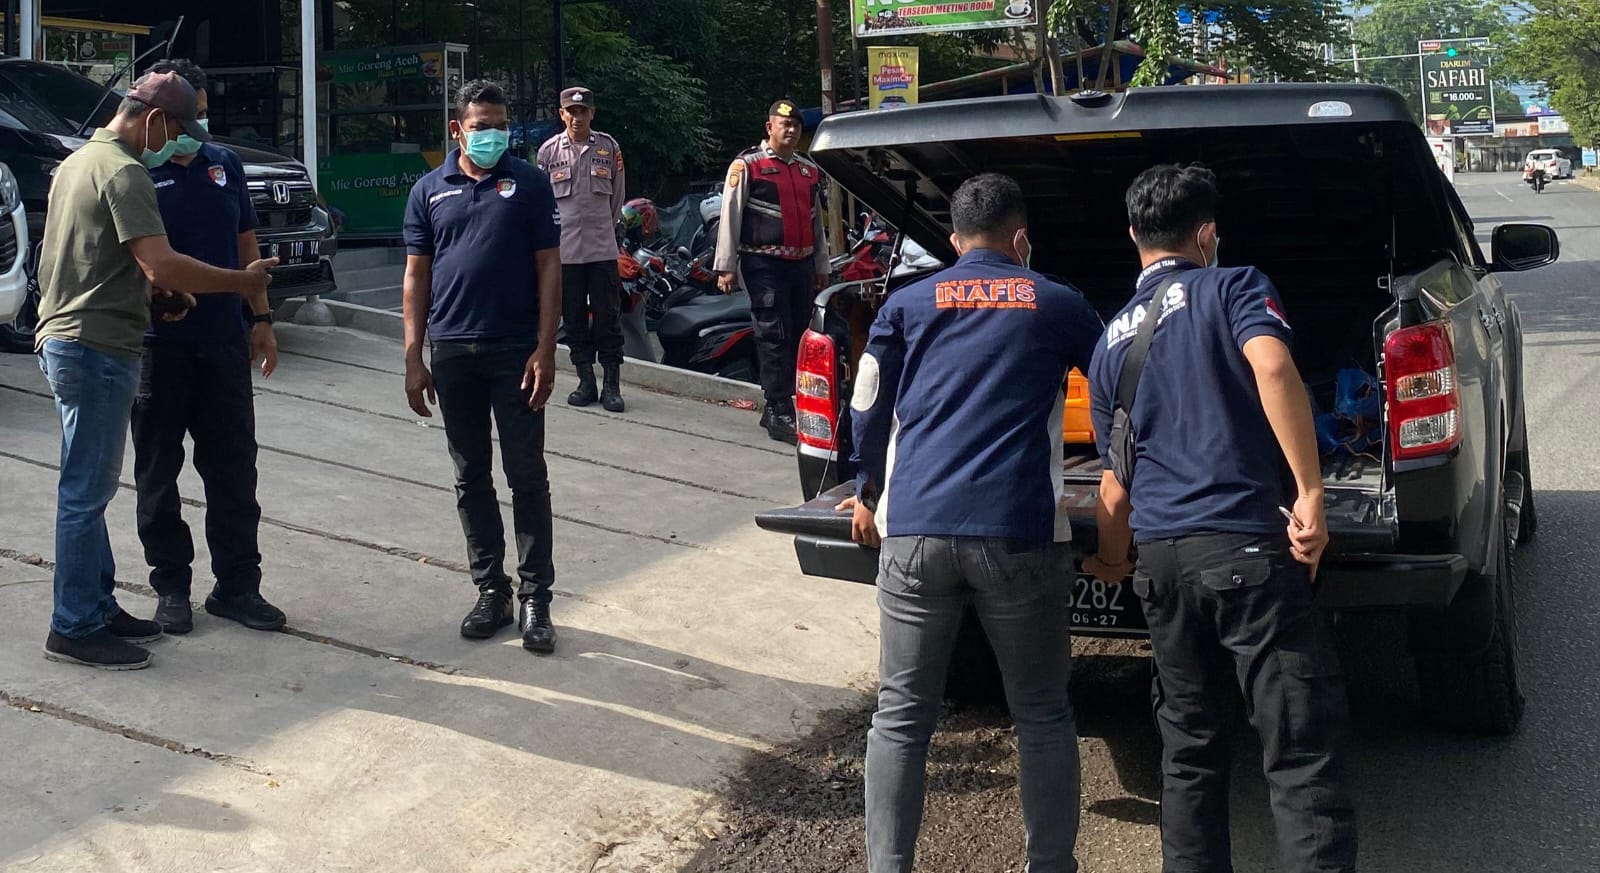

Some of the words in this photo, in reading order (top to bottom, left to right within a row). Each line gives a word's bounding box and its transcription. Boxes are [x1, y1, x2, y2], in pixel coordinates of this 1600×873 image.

[899, 7, 934, 16] TERSEDIA
[936, 5, 969, 13] MEETING
[971, 2, 993, 11] ROOM
[339, 64, 354, 73] Mie
[357, 59, 392, 72] Goreng
[394, 54, 418, 67] Aceh
[1428, 69, 1485, 88] SAFARI
[1449, 92, 1475, 101] 16.000
[331, 180, 350, 192] Mie
[354, 176, 396, 188] Goreng
[291, 242, 303, 257] 110
[936, 283, 1036, 303] INAFIS
